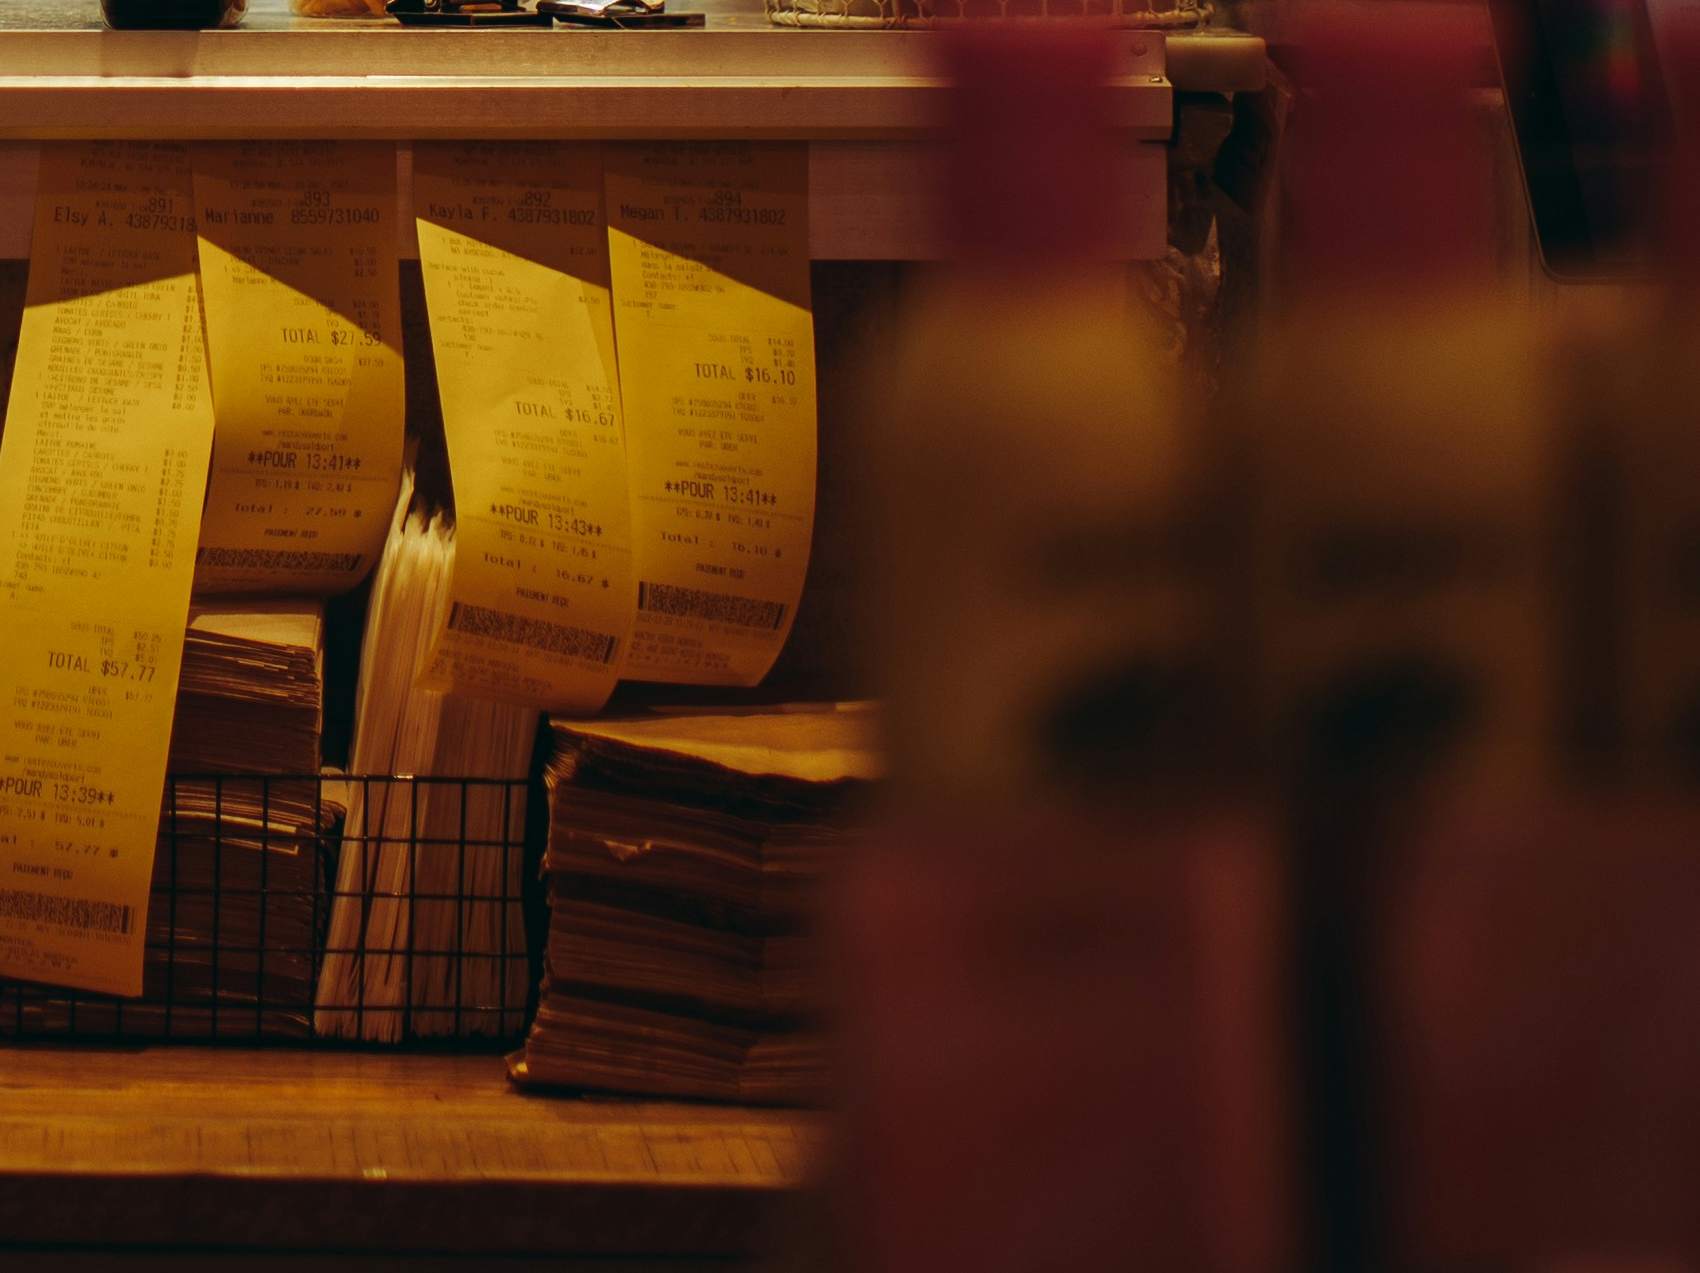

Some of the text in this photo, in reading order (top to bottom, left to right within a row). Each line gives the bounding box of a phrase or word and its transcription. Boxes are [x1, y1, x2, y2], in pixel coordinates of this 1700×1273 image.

[149, 198, 173, 213] 891
[303, 191, 330, 206] 893
[525, 192, 550, 207] 892
[714, 191, 741, 206] 894
[54, 206, 89, 226] Elsy
[98, 211, 113, 226] A.
[205, 208, 380, 224] Marianne 8559731040
[430, 204, 595, 225] Kayla F. 4387931802
[620, 205, 786, 225] Megan T. 4387931802
[282, 327, 381, 346] TOTAL $27.59
[695, 363, 795, 385] TOTAL $16.10
[514, 401, 615, 426] TOTAL $16.67
[235, 504, 346, 517] Total 27.59
[661, 531, 767, 555] Total 16.10
[484, 552, 593, 585] Total 16.67
[48, 651, 155, 682] TOTAL $57.77
[55, 841, 100, 856] 57.77
